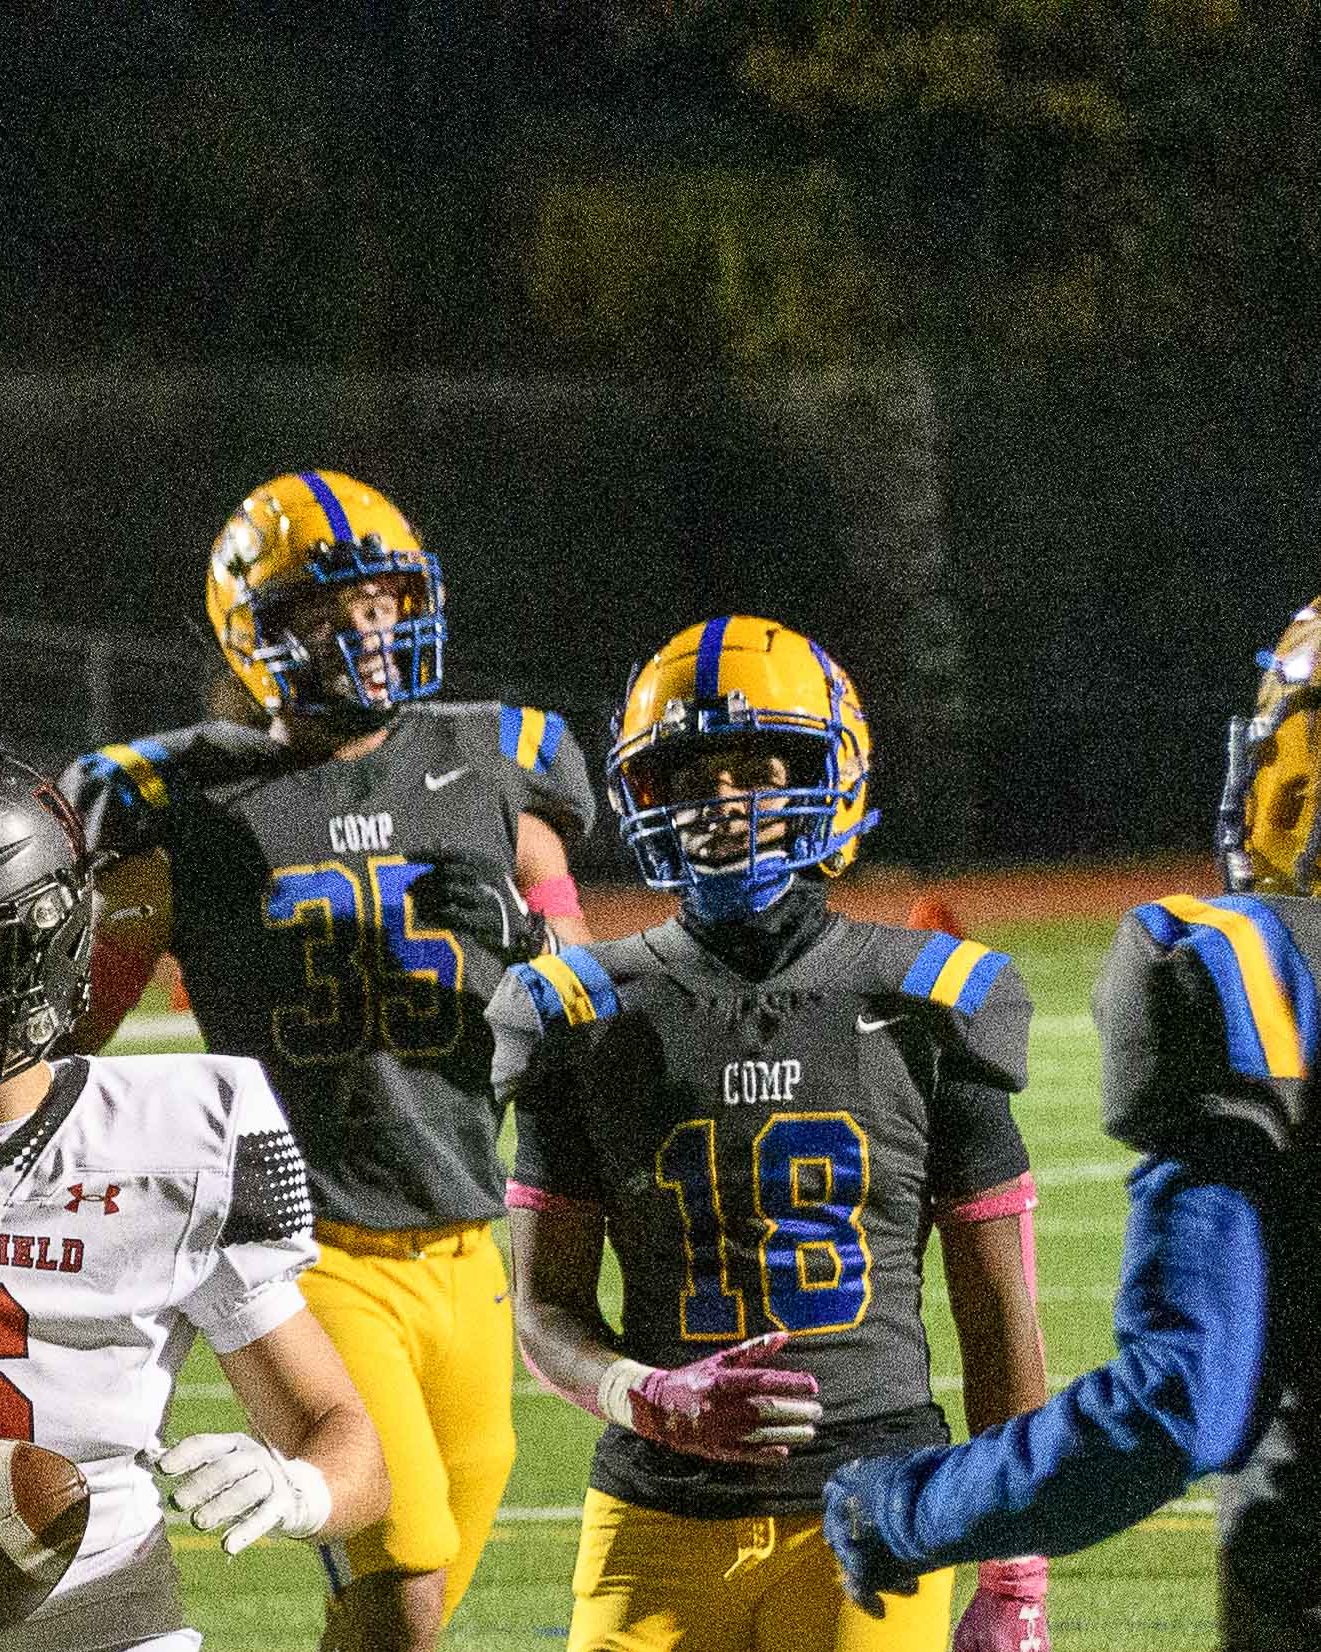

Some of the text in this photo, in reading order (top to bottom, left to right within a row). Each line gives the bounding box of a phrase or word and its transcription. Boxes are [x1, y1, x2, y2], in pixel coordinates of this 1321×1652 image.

[329, 811, 394, 853] COMP
[262, 855, 465, 1064] 35
[724, 1059, 801, 1104] COMP
[655, 1111, 871, 1341] 18
